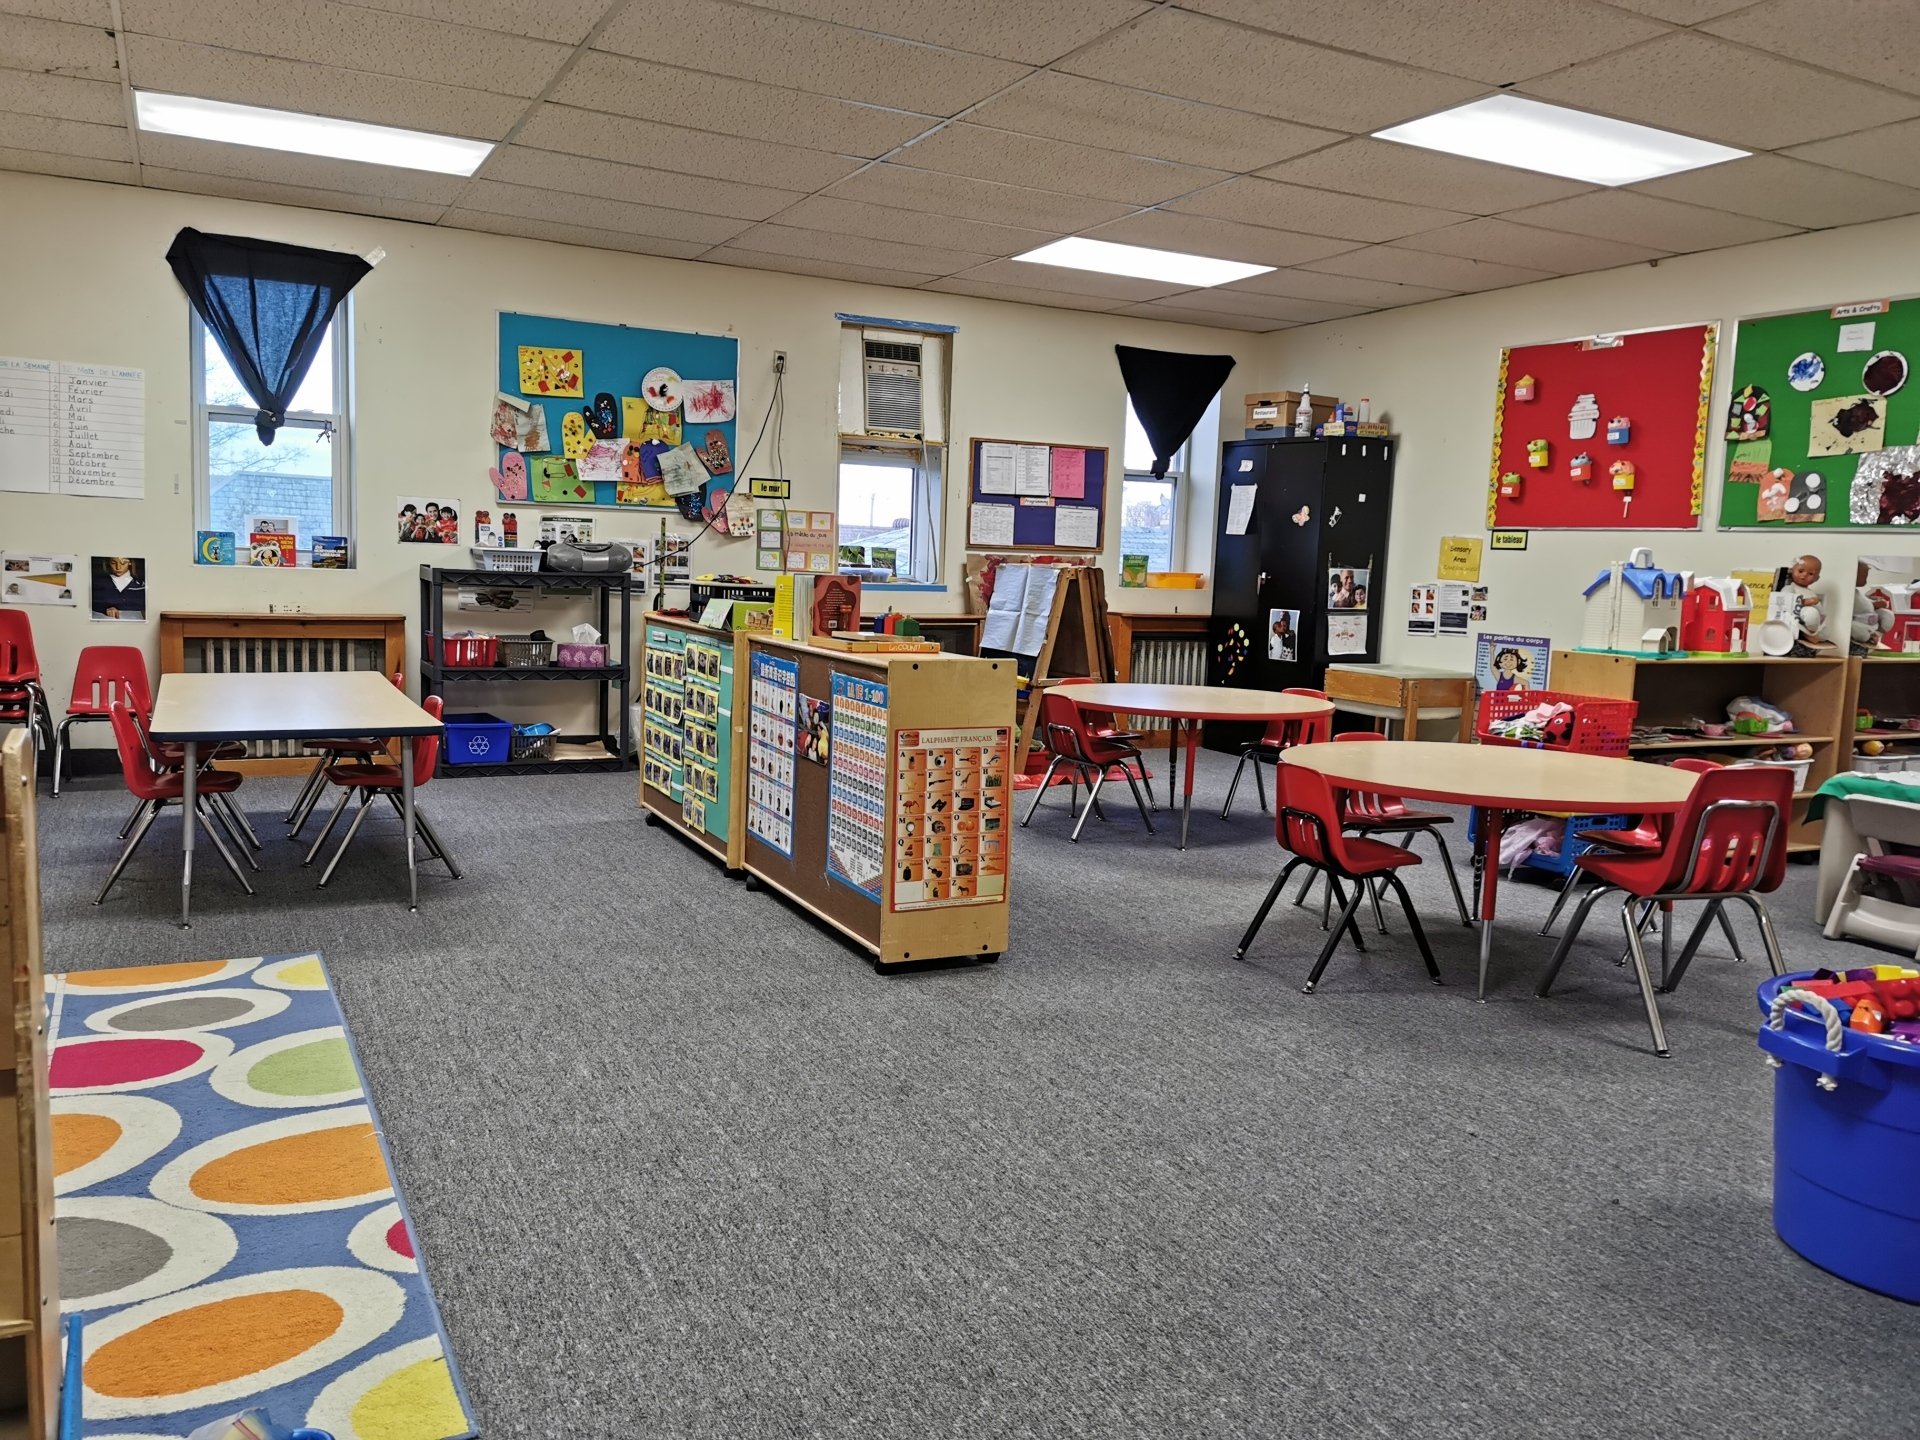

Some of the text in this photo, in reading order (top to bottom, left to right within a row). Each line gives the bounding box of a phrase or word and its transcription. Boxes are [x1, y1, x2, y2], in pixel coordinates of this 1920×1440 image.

[24, 362, 50, 371] SEMAINE
[68, 376, 108, 386] Janvier
[68, 394, 94, 404] Mars
[68, 404, 92, 412] Avril
[68, 412, 86, 421] Mai
[68, 422, 88, 430] Juin
[68, 430, 99, 440] Juillet
[68, 449, 120, 460] Septembre
[761, 484, 767, 492] le
[1496, 534, 1523, 544] le tableau
[1450, 546, 1472, 554] Sensory
